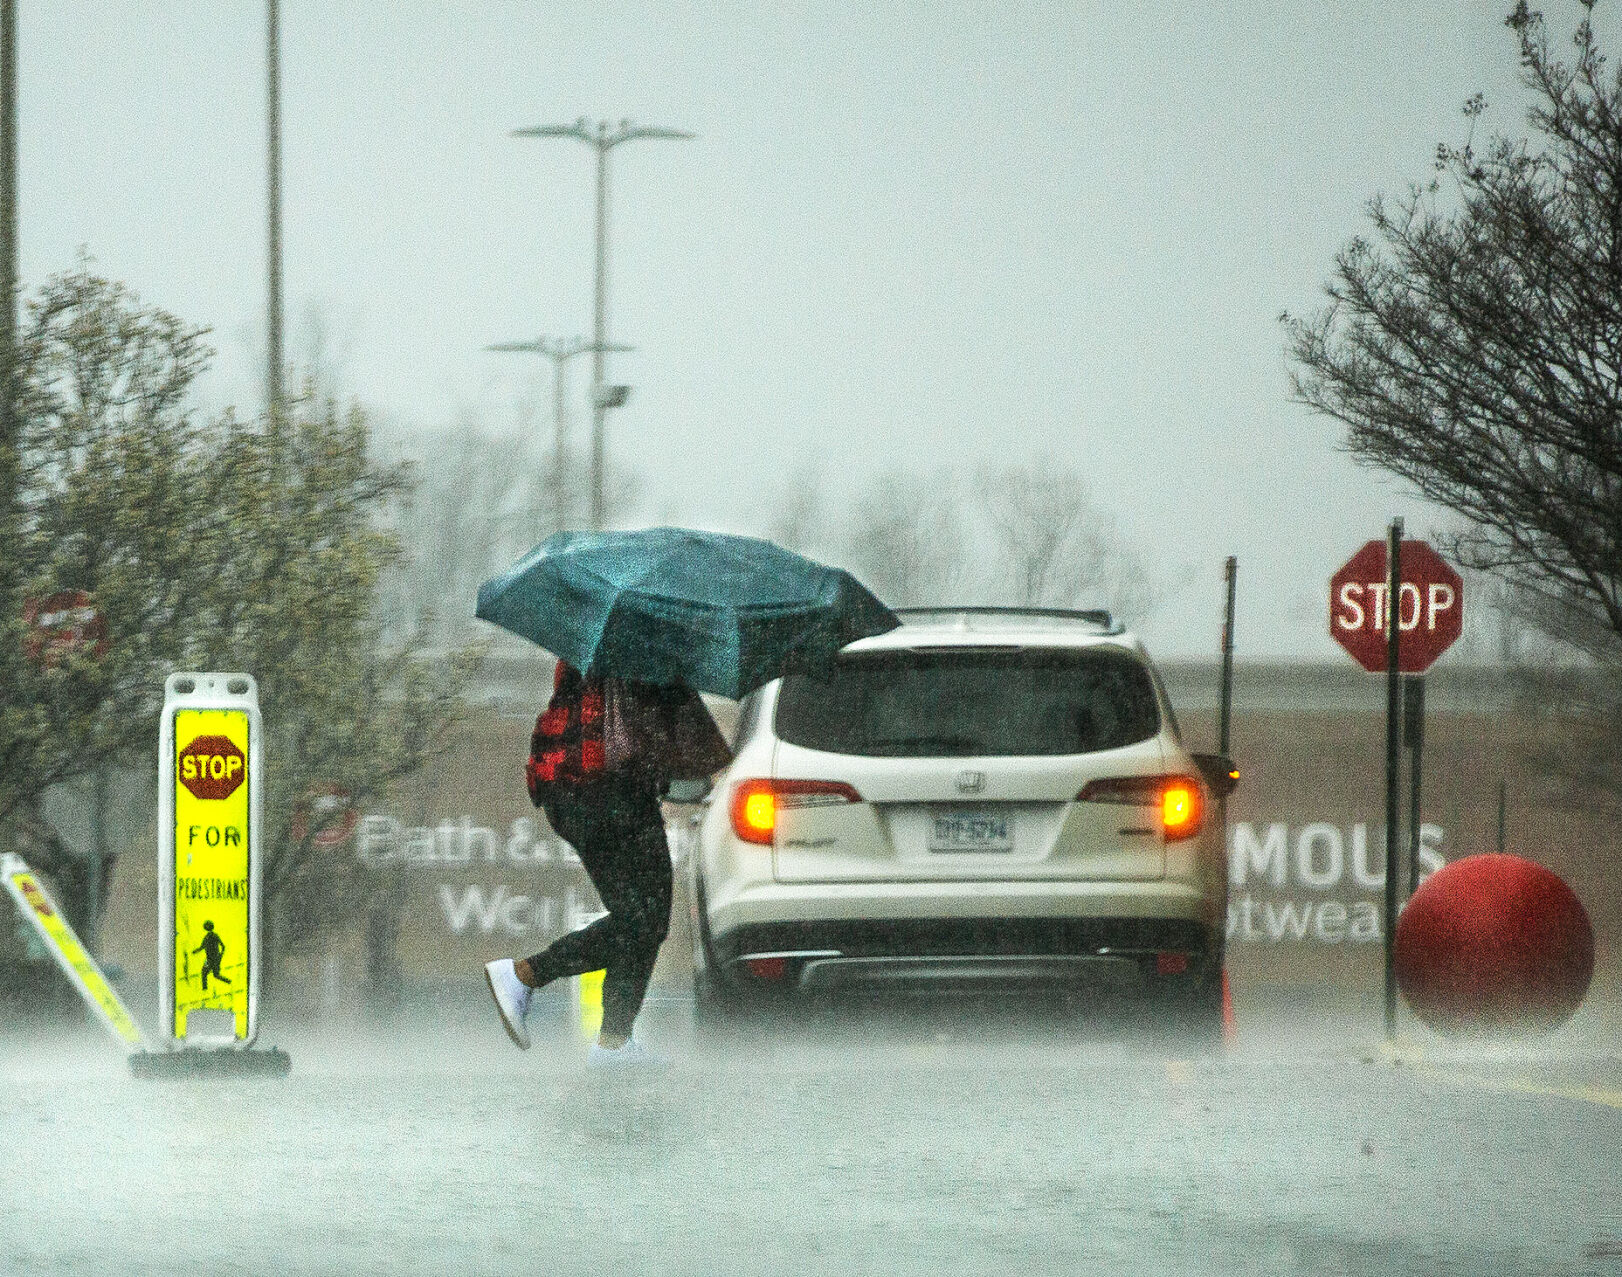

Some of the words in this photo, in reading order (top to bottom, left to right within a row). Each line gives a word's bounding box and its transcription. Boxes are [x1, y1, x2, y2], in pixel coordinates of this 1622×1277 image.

[1339, 582, 1455, 630] STOP
[182, 754, 243, 780] STOP
[189, 825, 241, 847] FOR
[357, 815, 496, 862] Bath
[1229, 821, 1446, 889] MOUS
[178, 877, 247, 901] PEDESTRIANS
